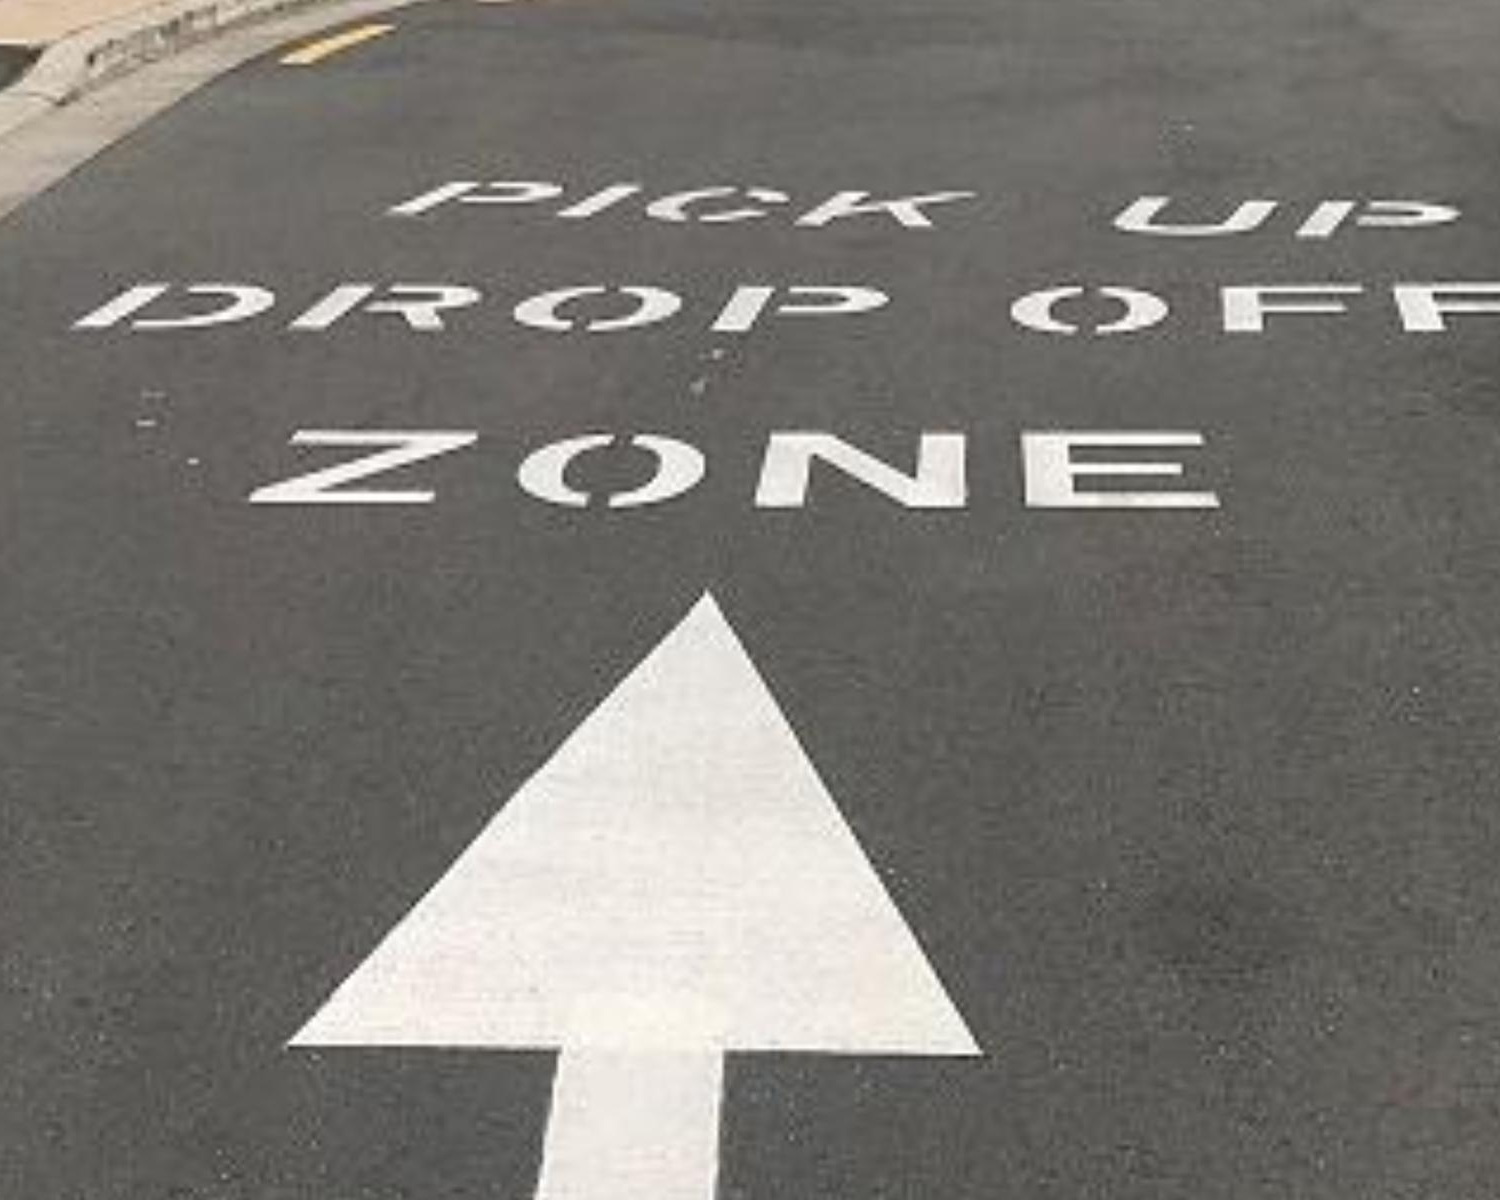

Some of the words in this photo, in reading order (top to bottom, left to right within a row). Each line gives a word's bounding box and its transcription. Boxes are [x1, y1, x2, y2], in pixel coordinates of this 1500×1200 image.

[387, 180, 977, 229] PICK
[1112, 195, 1463, 238] UP
[70, 284, 892, 333] DROP
[1009, 284, 1500, 334] OFF
[247, 429, 1221, 509] ZONE
